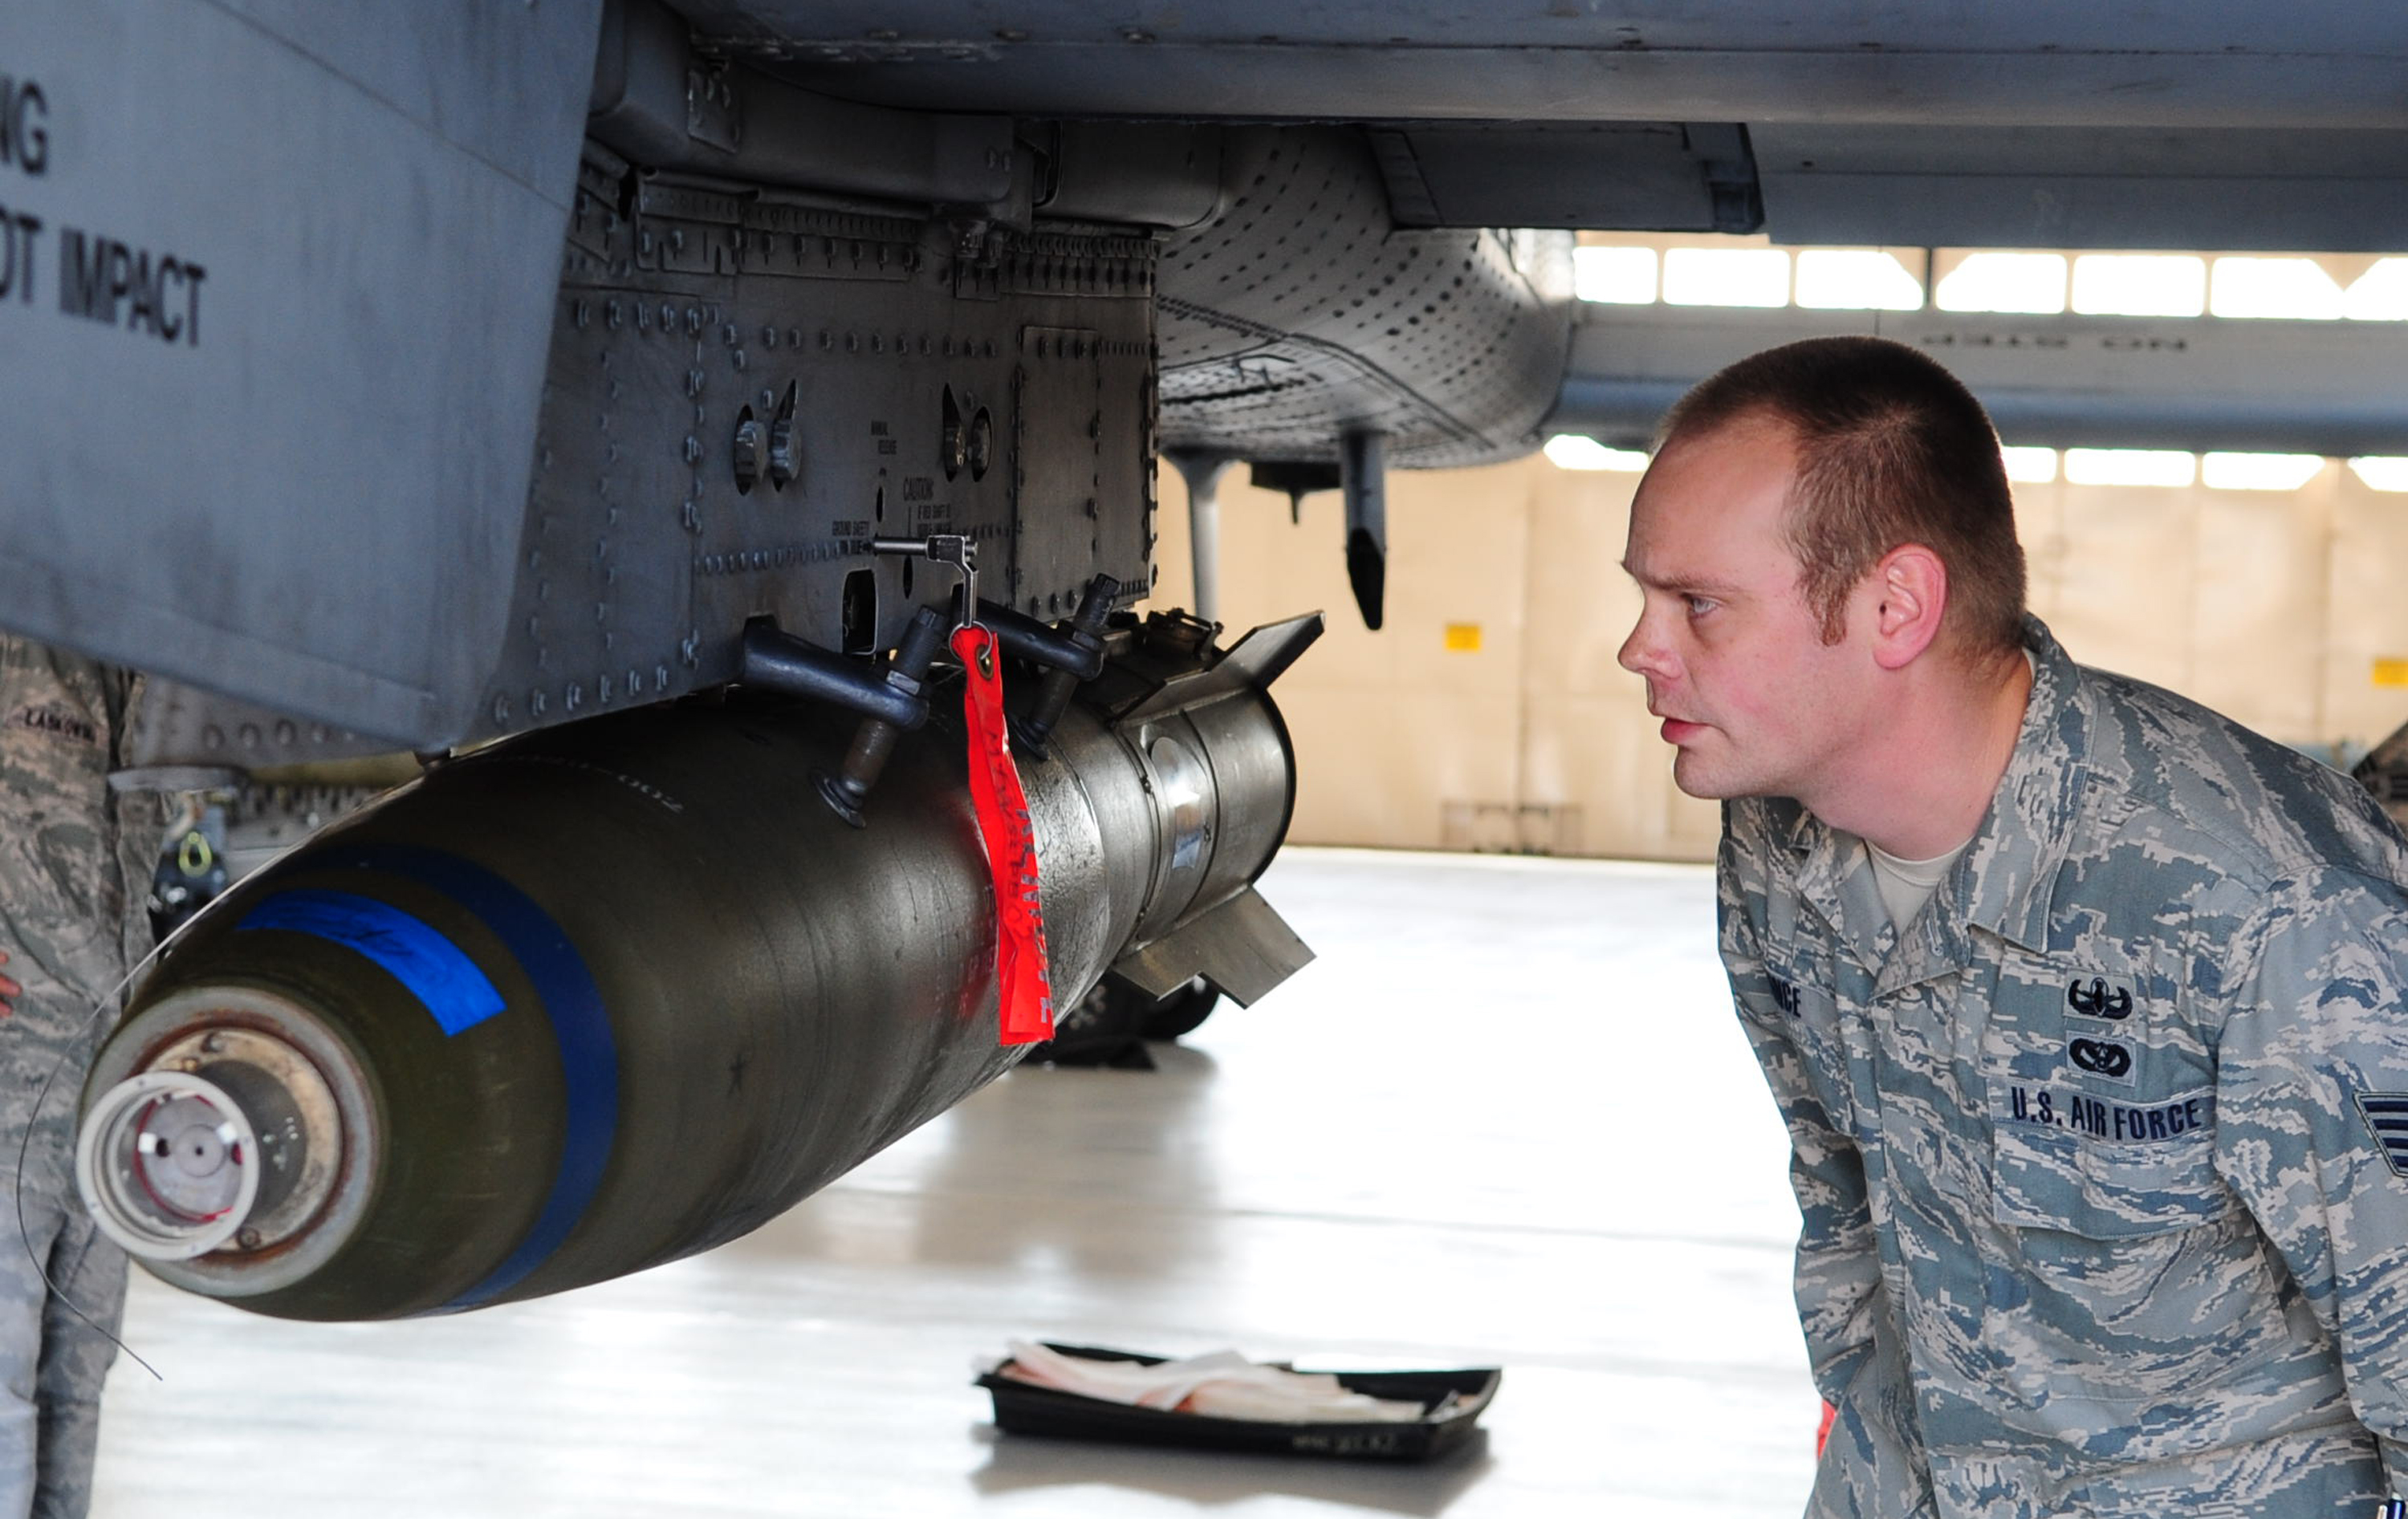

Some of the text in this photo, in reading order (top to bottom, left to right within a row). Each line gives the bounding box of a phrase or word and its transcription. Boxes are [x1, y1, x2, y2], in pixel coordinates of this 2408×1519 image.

[59, 225, 206, 347] IMPACT
[1921, 331, 2187, 351] NO STEP
[2011, 1086, 2202, 1140] U.S. AIR FORCE
